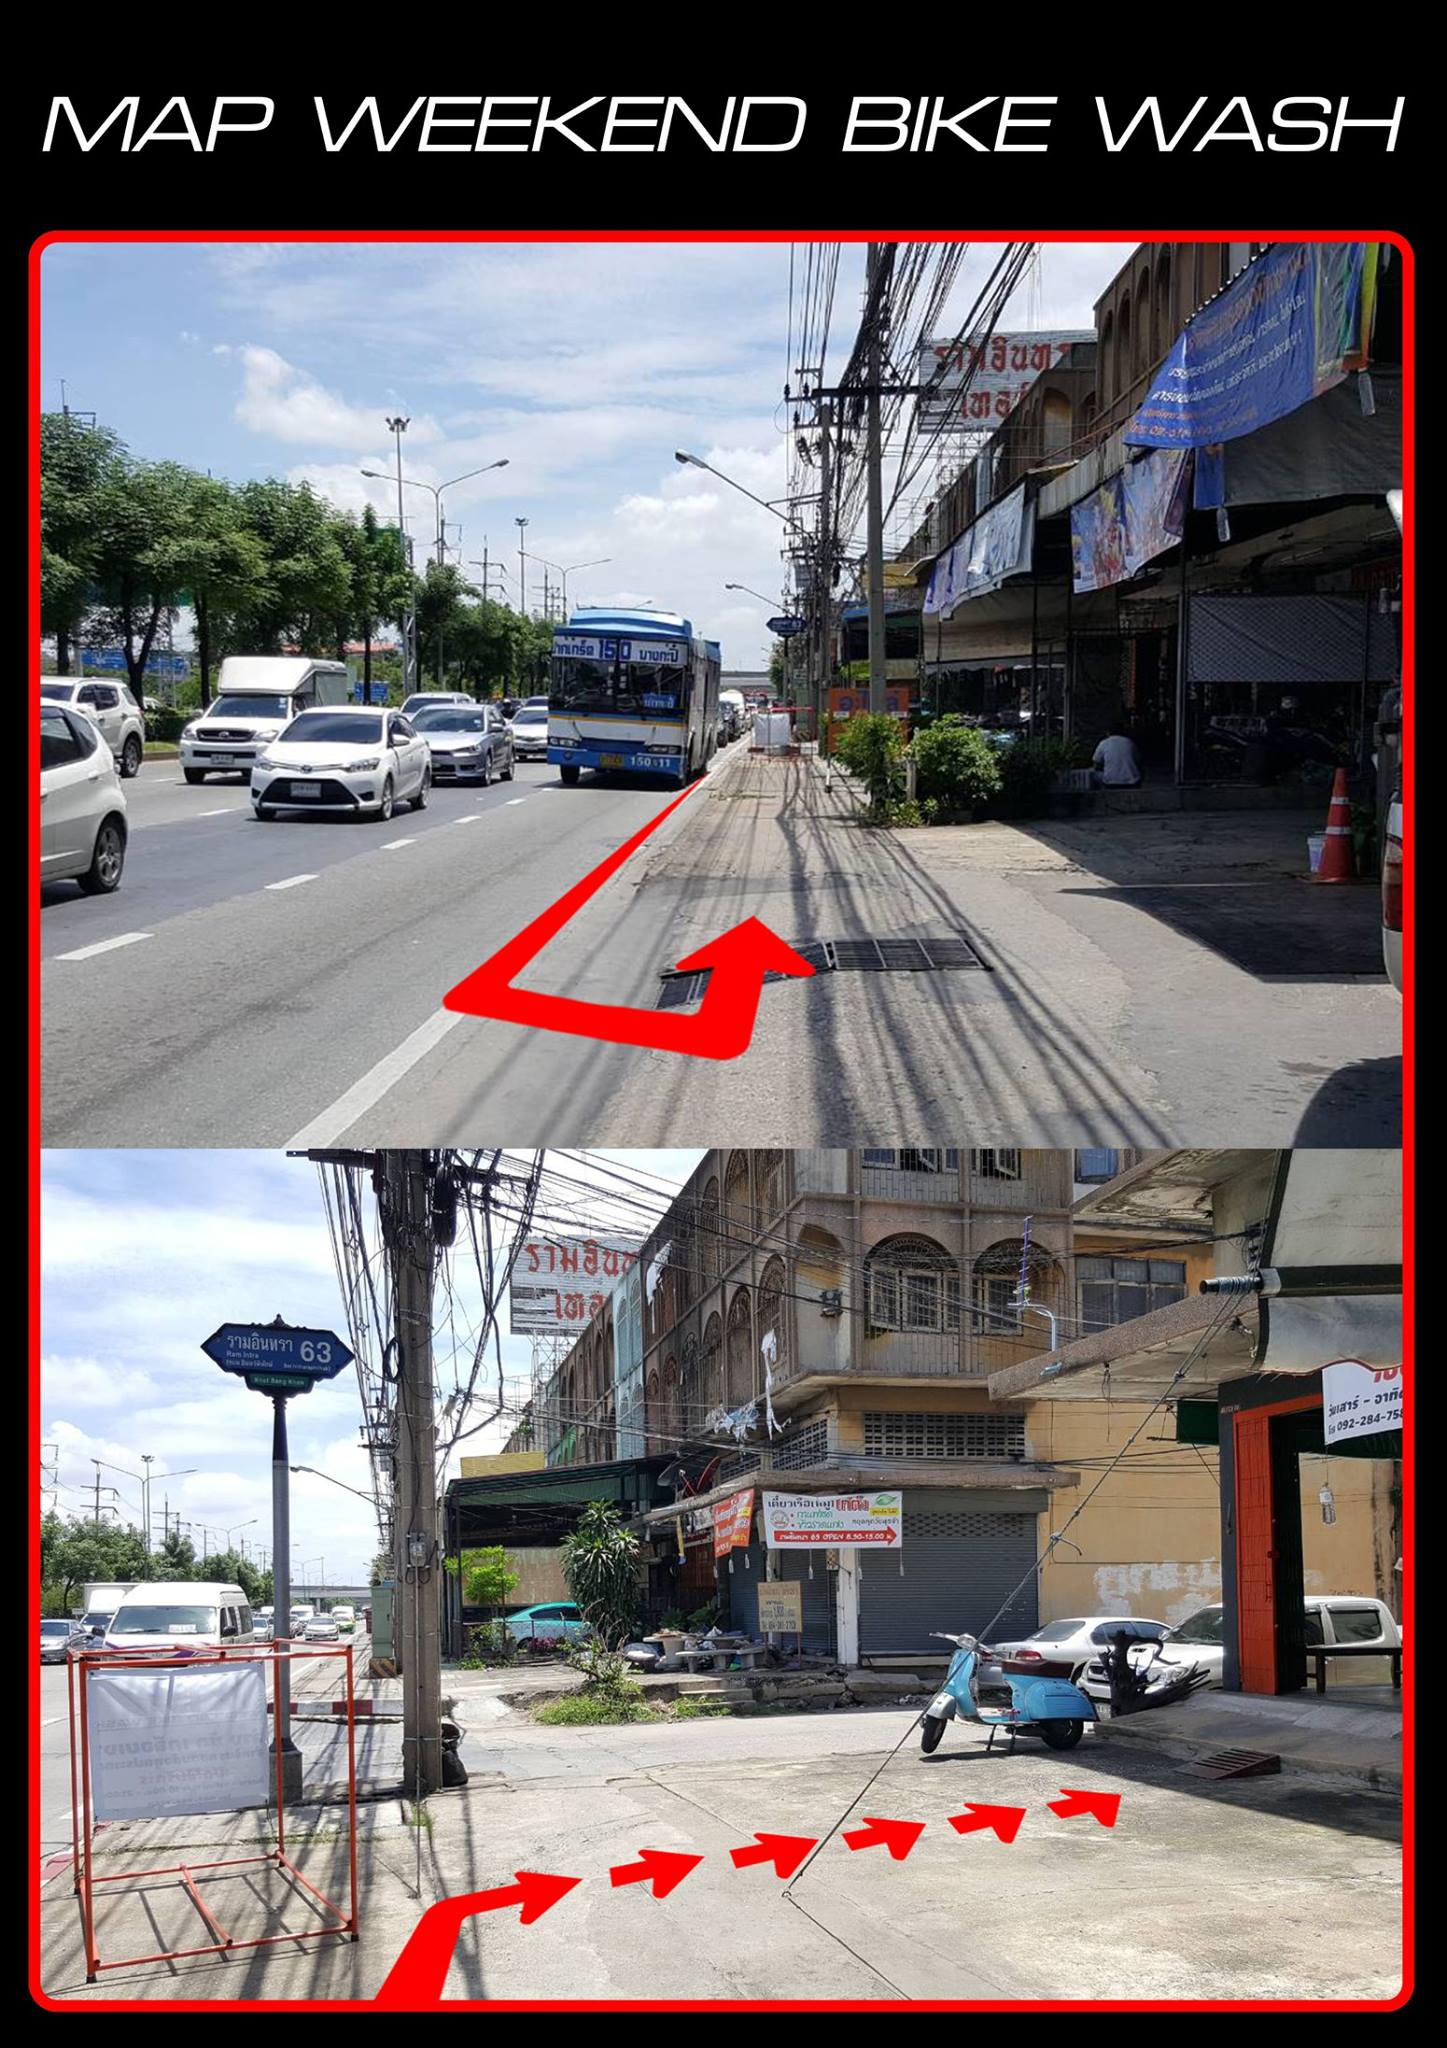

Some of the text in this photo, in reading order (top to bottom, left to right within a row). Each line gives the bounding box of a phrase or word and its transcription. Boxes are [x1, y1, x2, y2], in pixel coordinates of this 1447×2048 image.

[599, 639, 632, 660] 150
[226, 1332, 332, 1363] รามอินทรา 63
